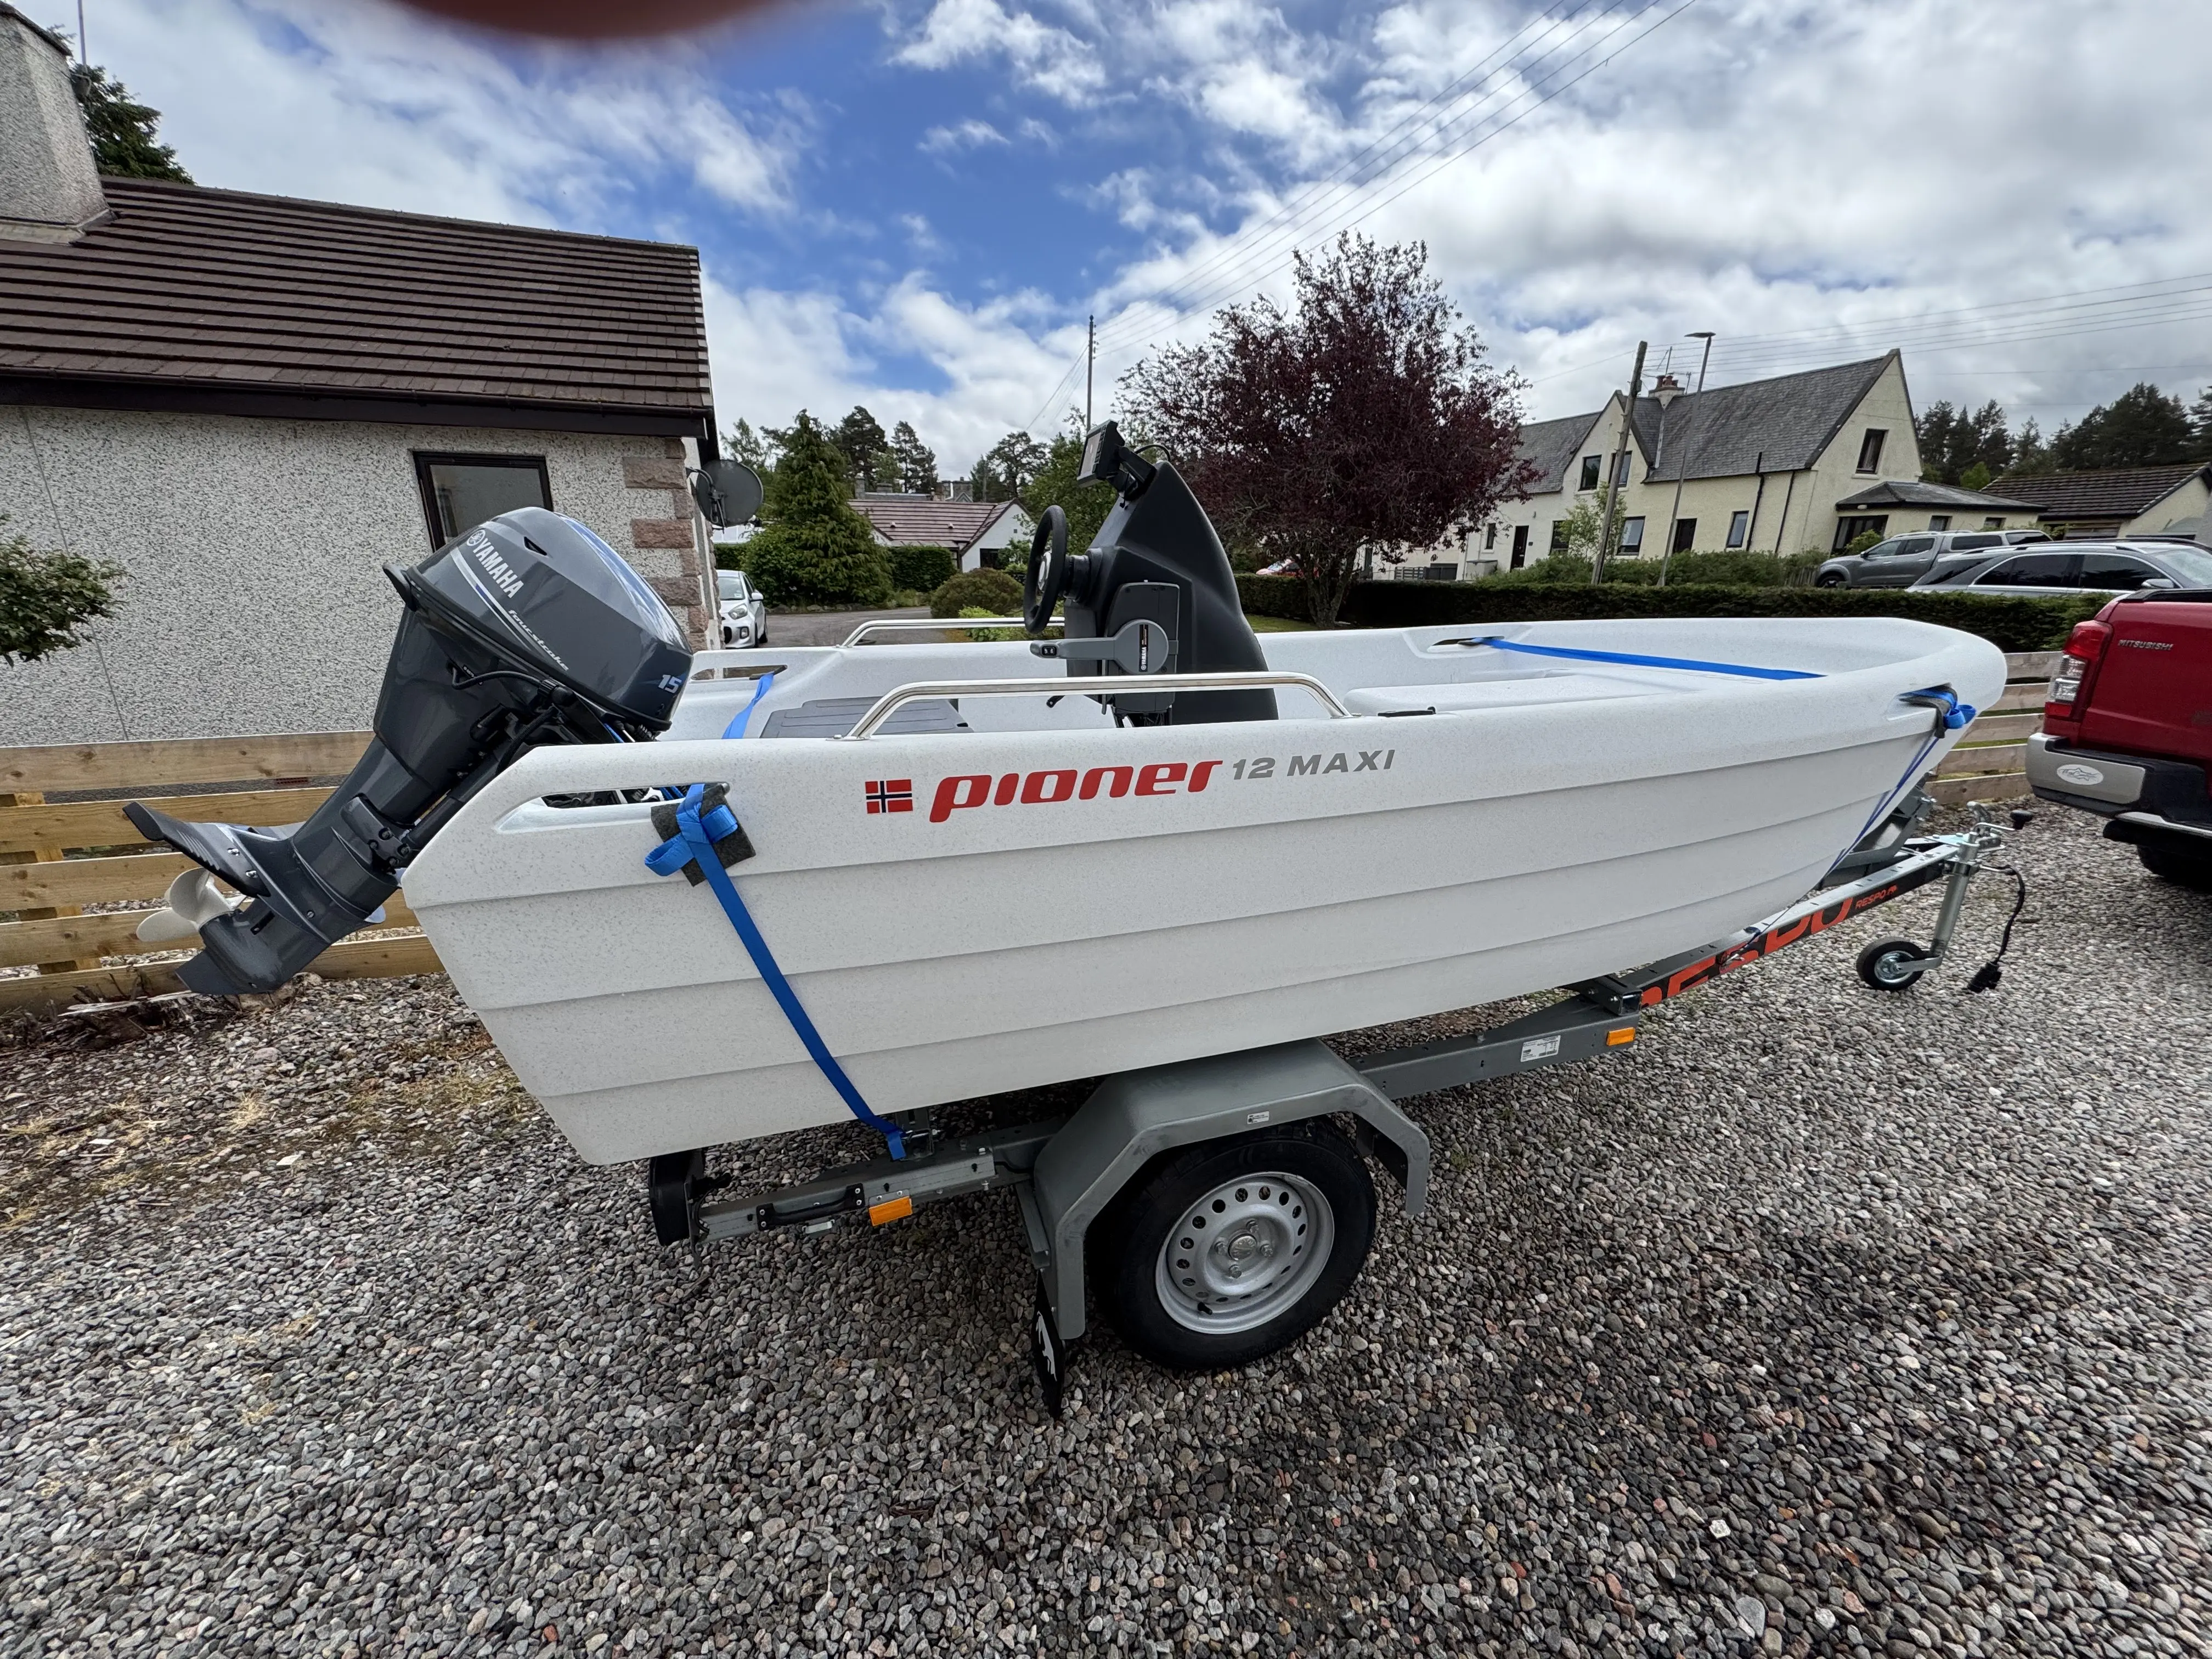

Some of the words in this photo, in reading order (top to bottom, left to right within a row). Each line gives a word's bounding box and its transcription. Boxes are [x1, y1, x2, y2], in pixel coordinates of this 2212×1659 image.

[472, 538, 524, 599] YAMAHA
[2118, 639, 2174, 651] MITSUBISHI
[658, 674, 682, 693] 15
[929, 760, 1223, 823] pioner
[1233, 758, 1276, 780] 12
[1286, 749, 1395, 777] MAXI
[1855, 889, 1886, 909] RESPO
